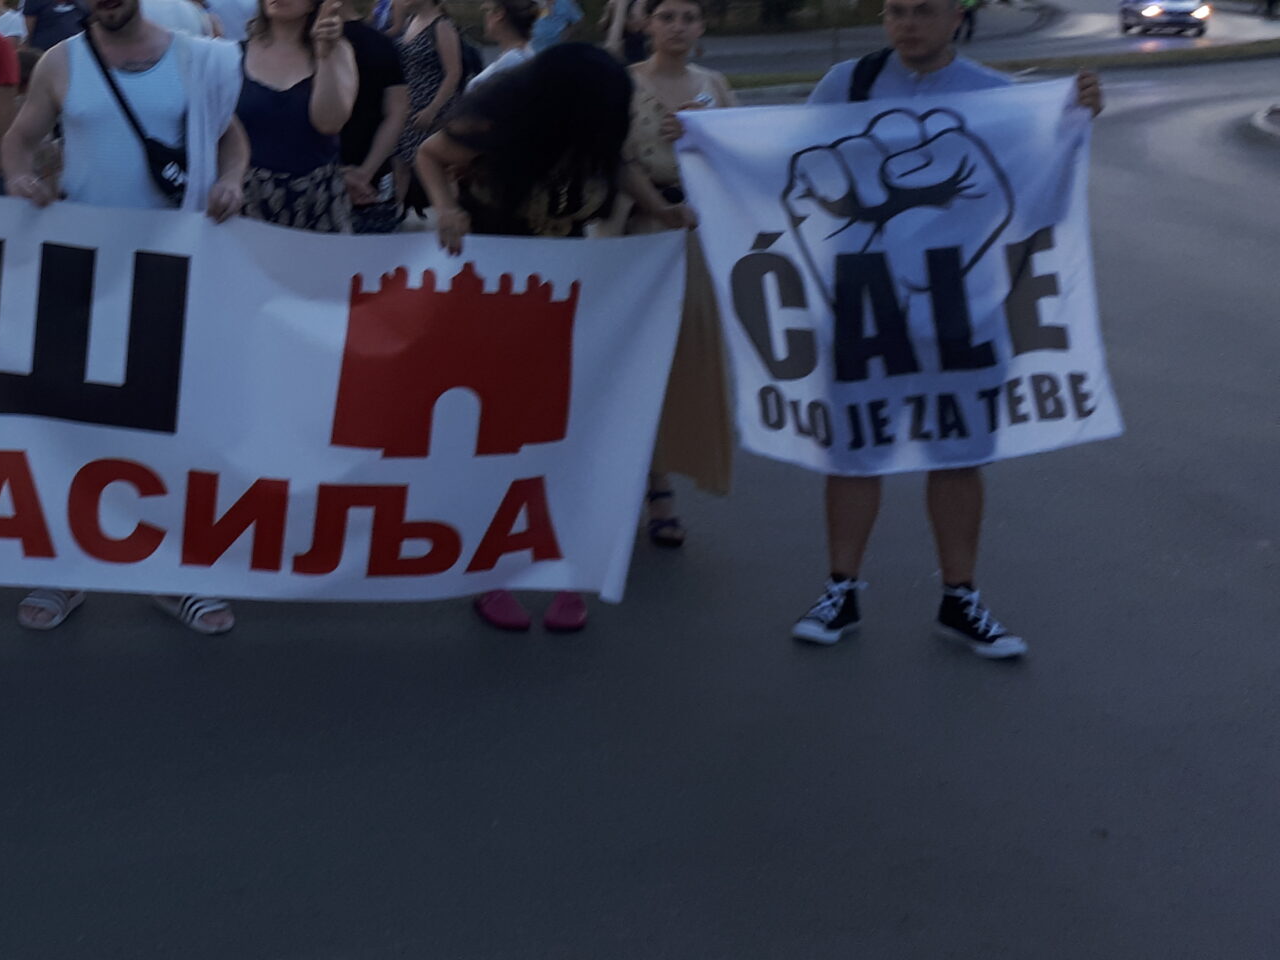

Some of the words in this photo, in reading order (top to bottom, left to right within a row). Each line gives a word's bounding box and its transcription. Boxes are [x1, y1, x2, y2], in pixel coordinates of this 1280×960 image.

[730, 226, 1070, 382] ĆALE
[845, 399, 896, 451] JE
[904, 393, 971, 440] ZA
[977, 372, 1098, 434] TEBE
